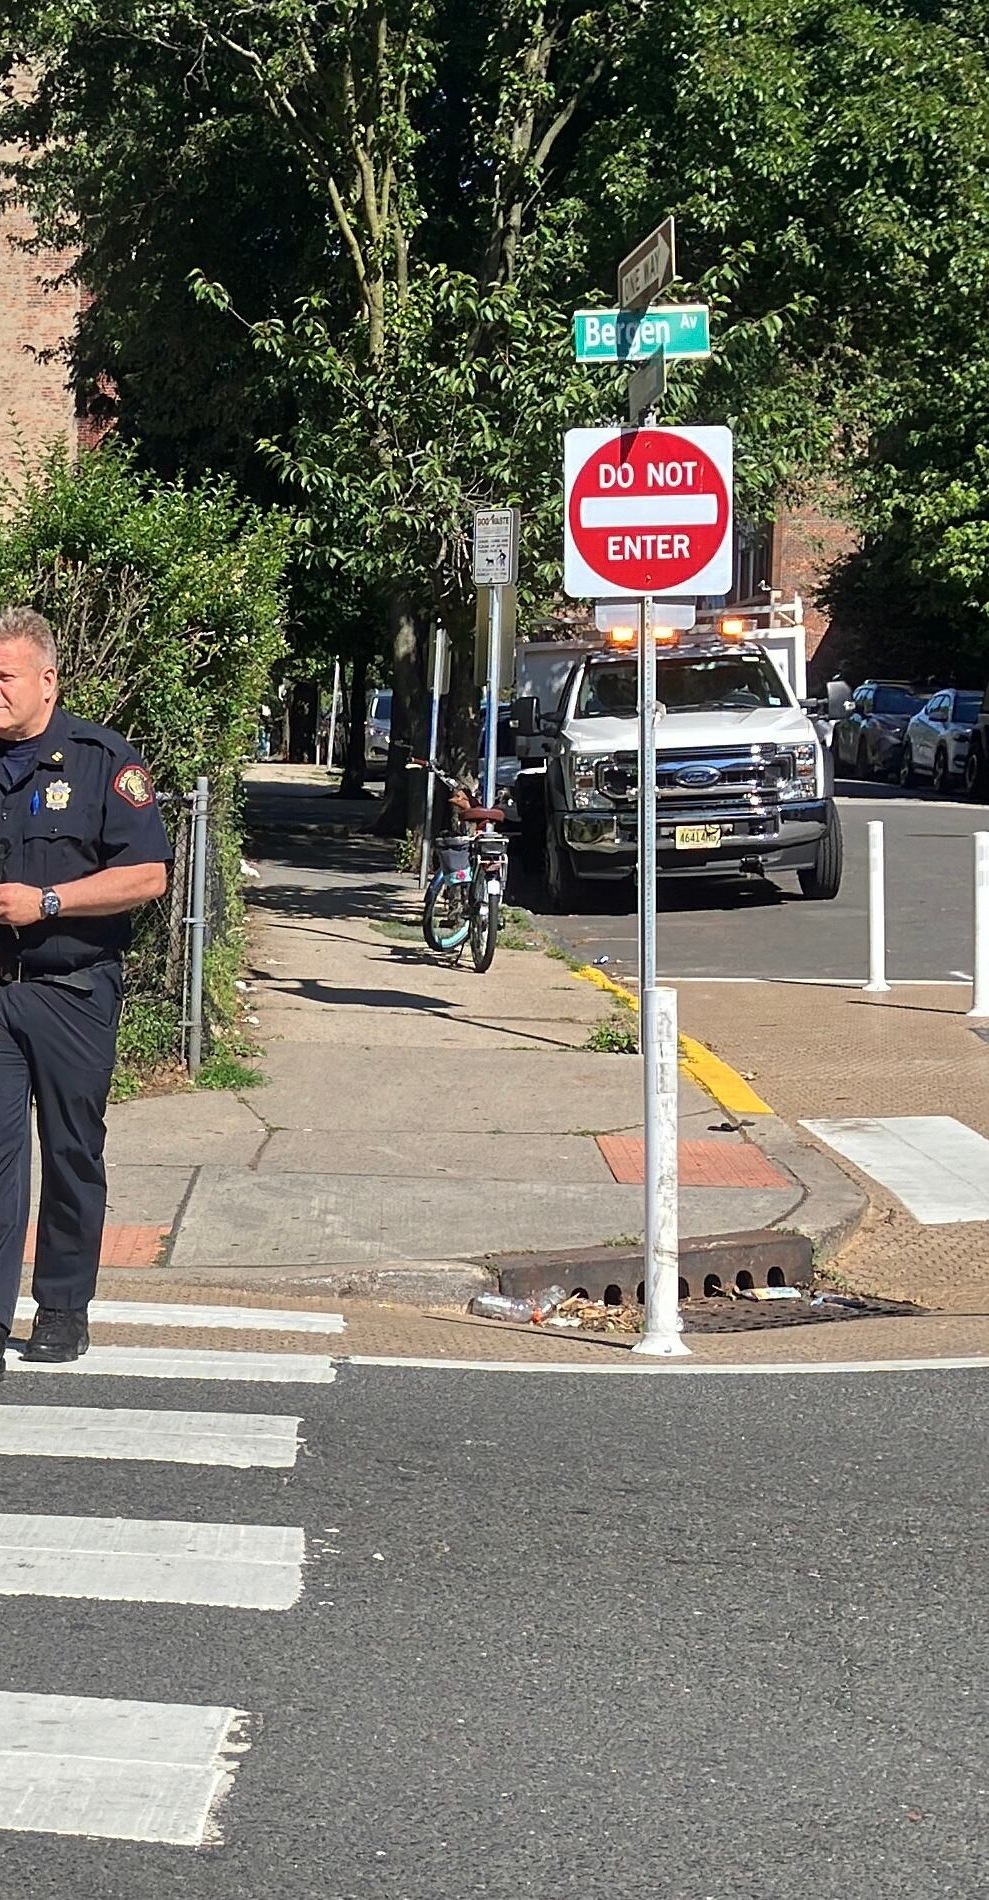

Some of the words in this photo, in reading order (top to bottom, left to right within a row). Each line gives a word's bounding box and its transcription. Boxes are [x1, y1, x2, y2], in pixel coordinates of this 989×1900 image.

[624, 266, 641, 303] ONE
[642, 247, 660, 284] WAY
[585, 317, 670, 355] Bergen
[680, 314, 698, 329] Av
[599, 462, 634, 489] DO
[647, 461, 698, 488] NOT
[607, 534, 690, 560] ENTER
